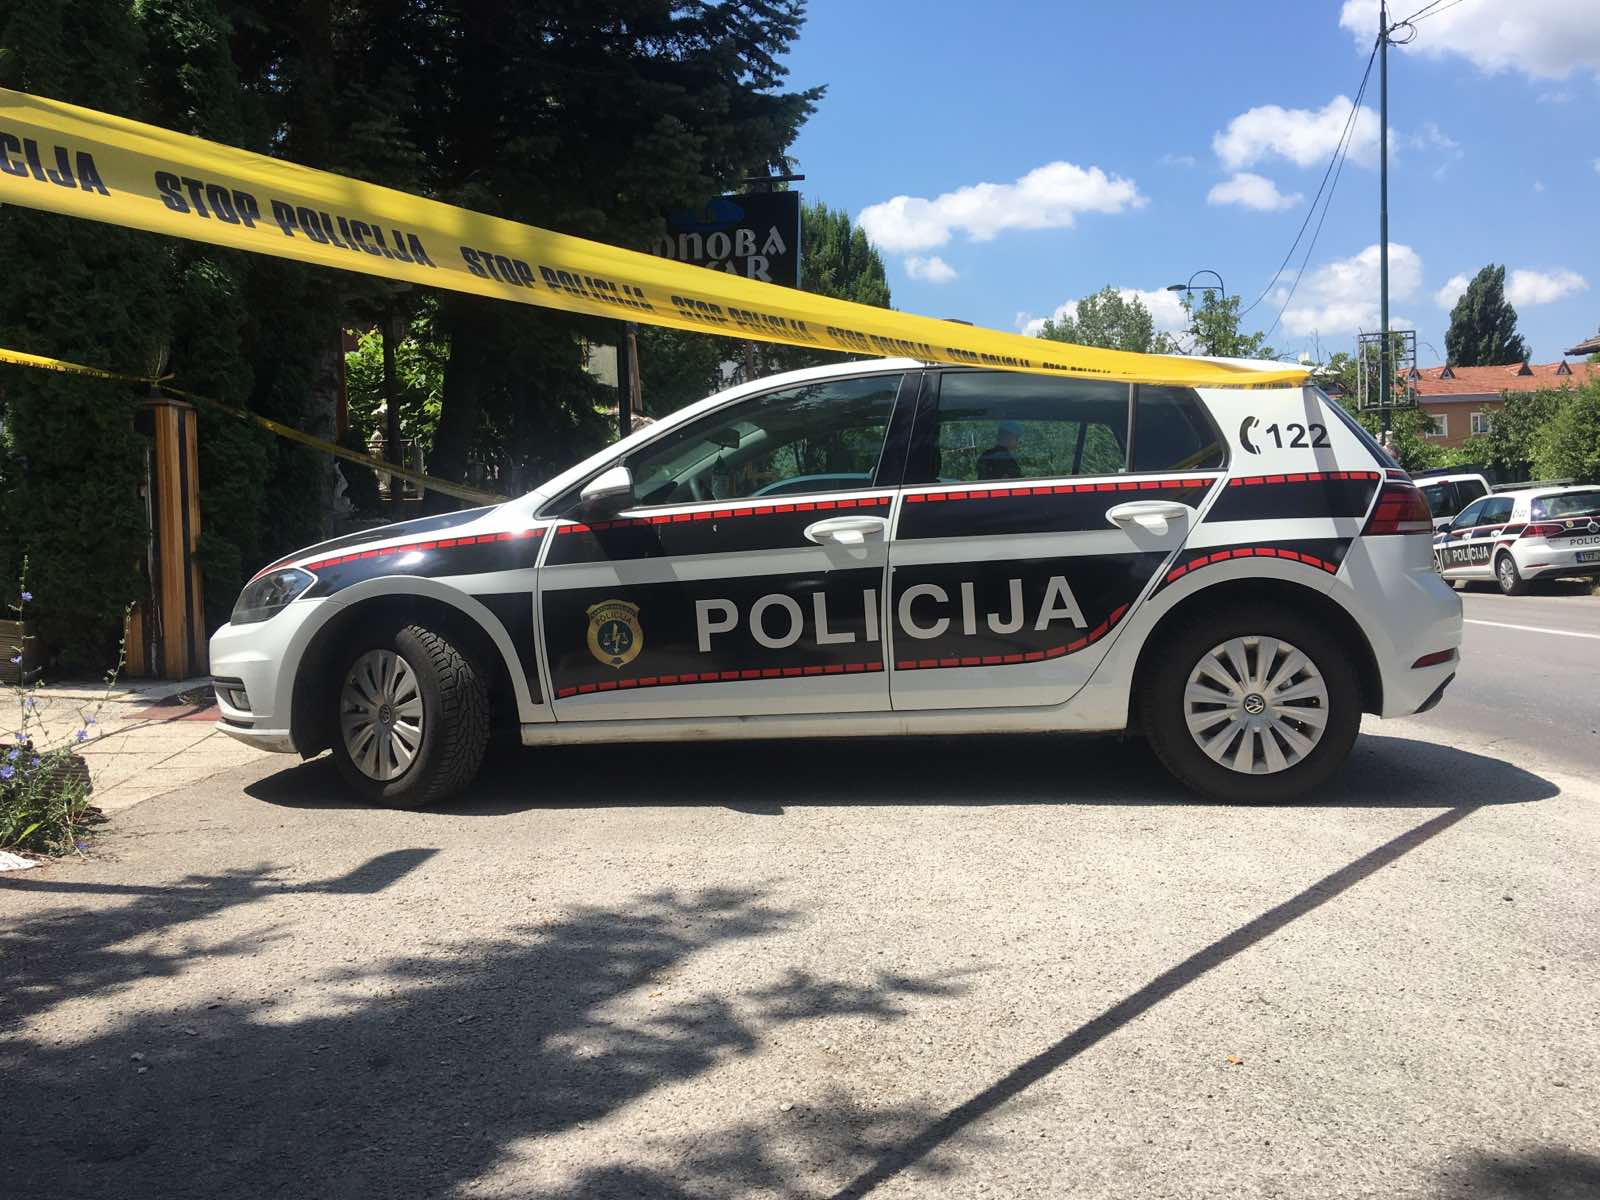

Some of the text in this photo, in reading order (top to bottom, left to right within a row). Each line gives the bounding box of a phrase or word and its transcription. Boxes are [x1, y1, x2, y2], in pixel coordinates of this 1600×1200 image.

[154, 170, 437, 269] STOP POLICIJA
[459, 246, 535, 289] STOP
[1266, 423, 1331, 449] 122
[1452, 546, 1489, 561] POLICIJA
[695, 576, 1088, 653] POLICIJA
